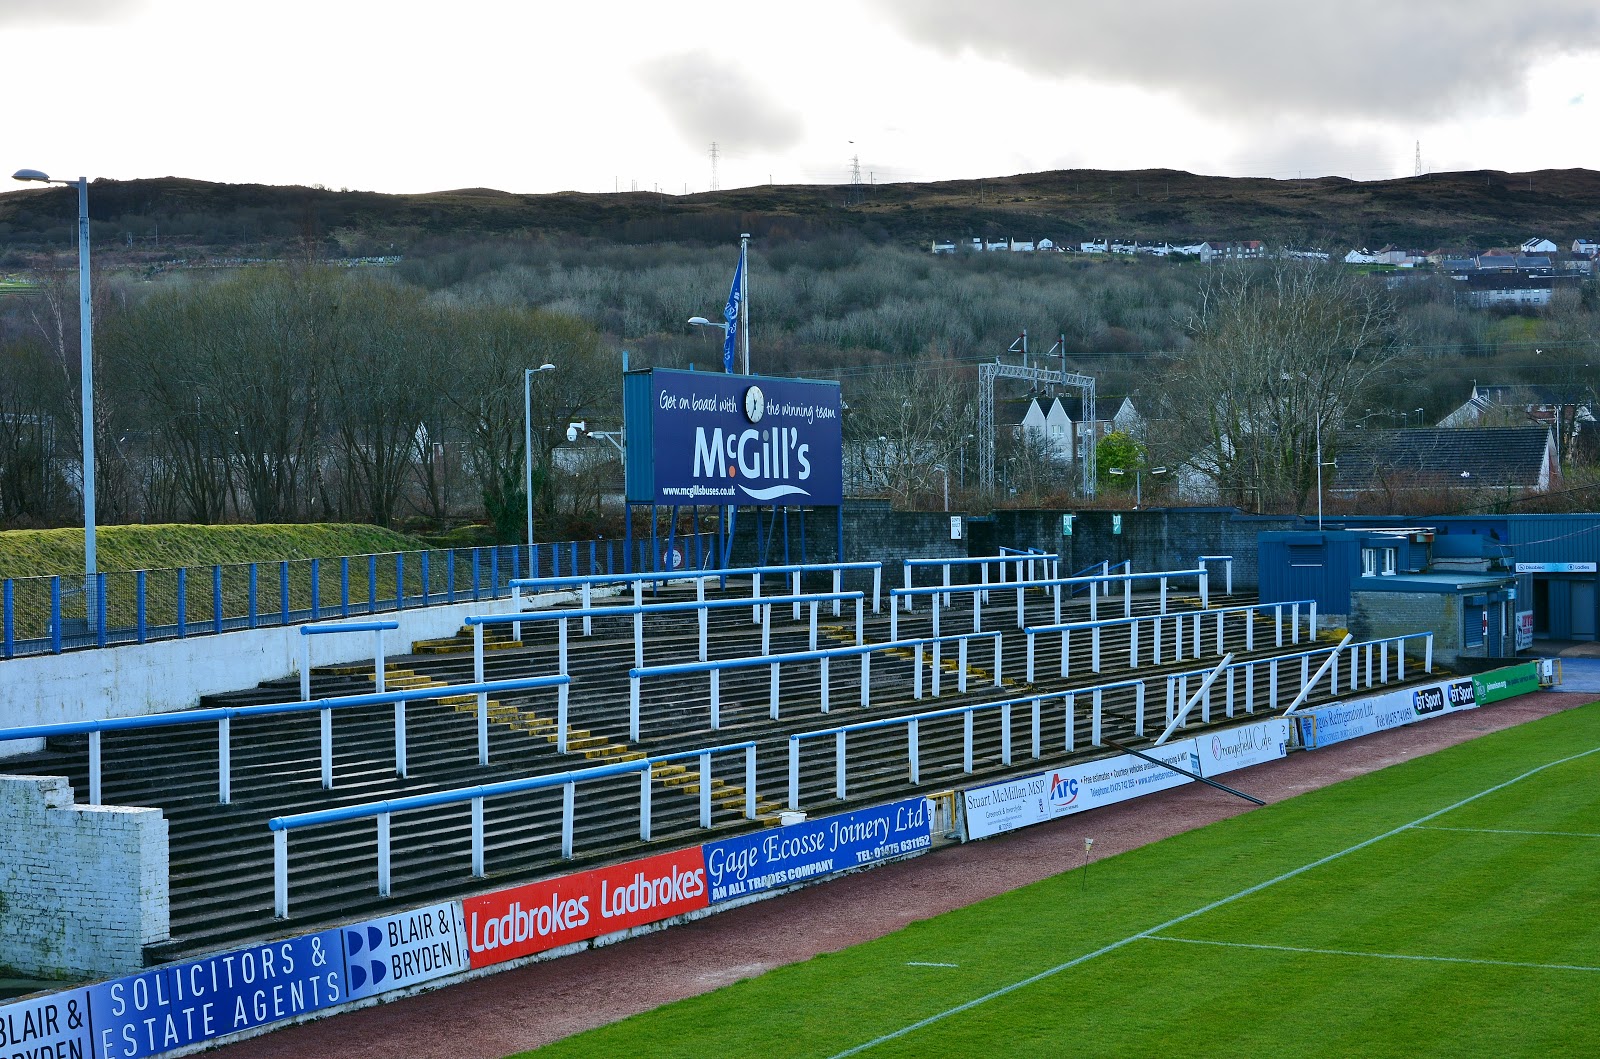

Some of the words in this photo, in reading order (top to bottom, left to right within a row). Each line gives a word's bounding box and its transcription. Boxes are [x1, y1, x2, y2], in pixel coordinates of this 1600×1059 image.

[660, 390, 676, 409] Get
[680, 398, 689, 409] on
[692, 393, 716, 412] board
[720, 396, 737, 413] with
[767, 400, 780, 416] the
[782, 403, 813, 424] winning
[816, 406, 836, 419] team
[693, 427, 810, 480] McGill's
[663, 486, 735, 499] www.mcgillsbuses.co.uk
[1416, 695, 1425, 710] BT
[1425, 691, 1441, 710] Sport
[1451, 688, 1459, 702] BT
[1459, 685, 1474, 703] Sport
[1050, 774, 1078, 800] Arc
[1092, 772, 1110, 781] estimates
[967, 795, 991, 810] Stuart
[992, 786, 1027, 804] McMillan
[1028, 780, 1044, 796] MSP
[709, 846, 758, 886] Gage
[763, 831, 825, 863] Ecosse
[830, 816, 889, 852] Joinery
[895, 798, 926, 832] Ltd
[856, 850, 874, 863] TEL:
[874, 842, 899, 858] 01475
[900, 835, 930, 852] 631152
[601, 864, 704, 918] Ladbrokes
[713, 886, 728, 900] AN
[729, 881, 746, 895] ALL
[747, 871, 787, 891] TRADES
[787, 859, 833, 880] COMPANY
[388, 913, 434, 947] BLAIR
[438, 910, 450, 934] &
[471, 894, 589, 953] Ladbrokes
[110, 944, 294, 1016] SOLICITORS
[311, 937, 326, 967] &
[392, 941, 452, 980] BRYDEN
[67, 999, 83, 1030] &
[102, 1003, 215, 1059] ESTATE
[234, 972, 340, 1027] AGENTS
